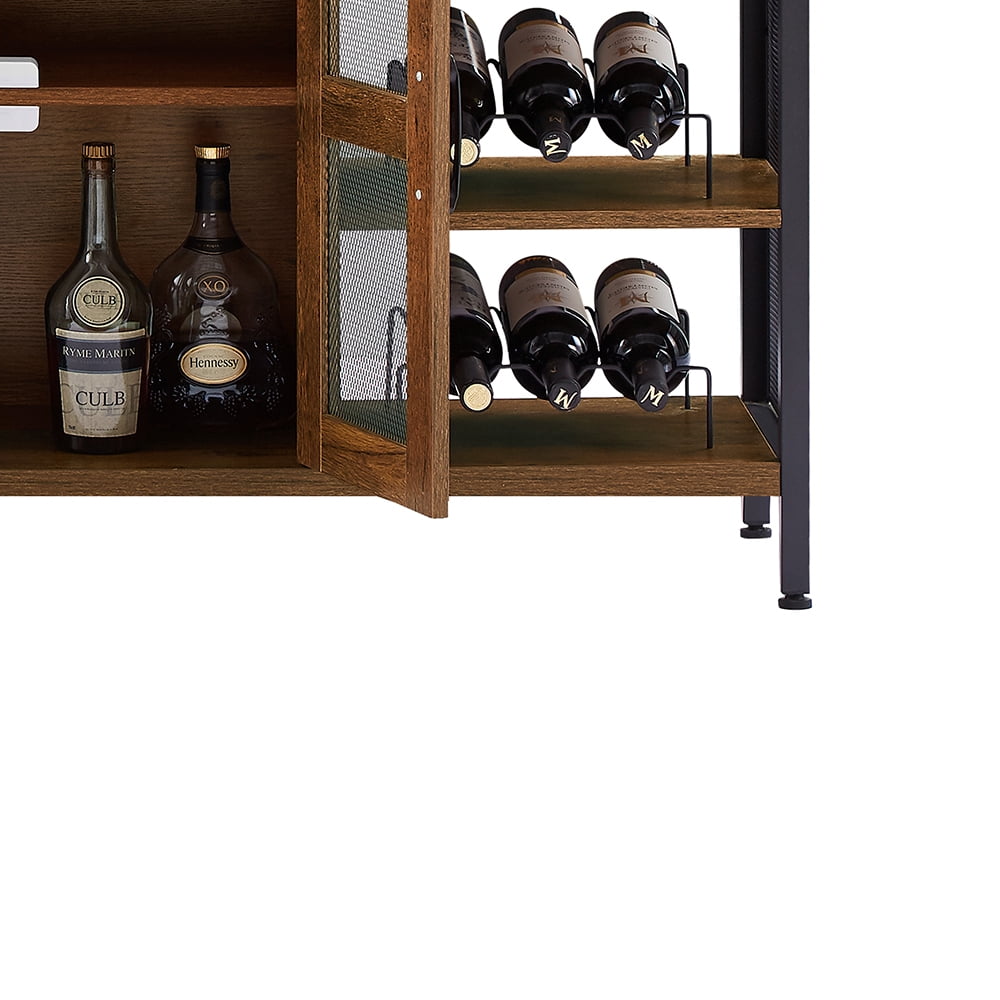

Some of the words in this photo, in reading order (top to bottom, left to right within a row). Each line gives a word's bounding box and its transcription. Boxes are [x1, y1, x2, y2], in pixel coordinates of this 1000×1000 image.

[629, 132, 653, 158] M
[83, 294, 117, 306] CULB
[62, 345, 92, 359] RYME
[189, 356, 239, 370] Hennessy
[75, 391, 126, 407] CULB
